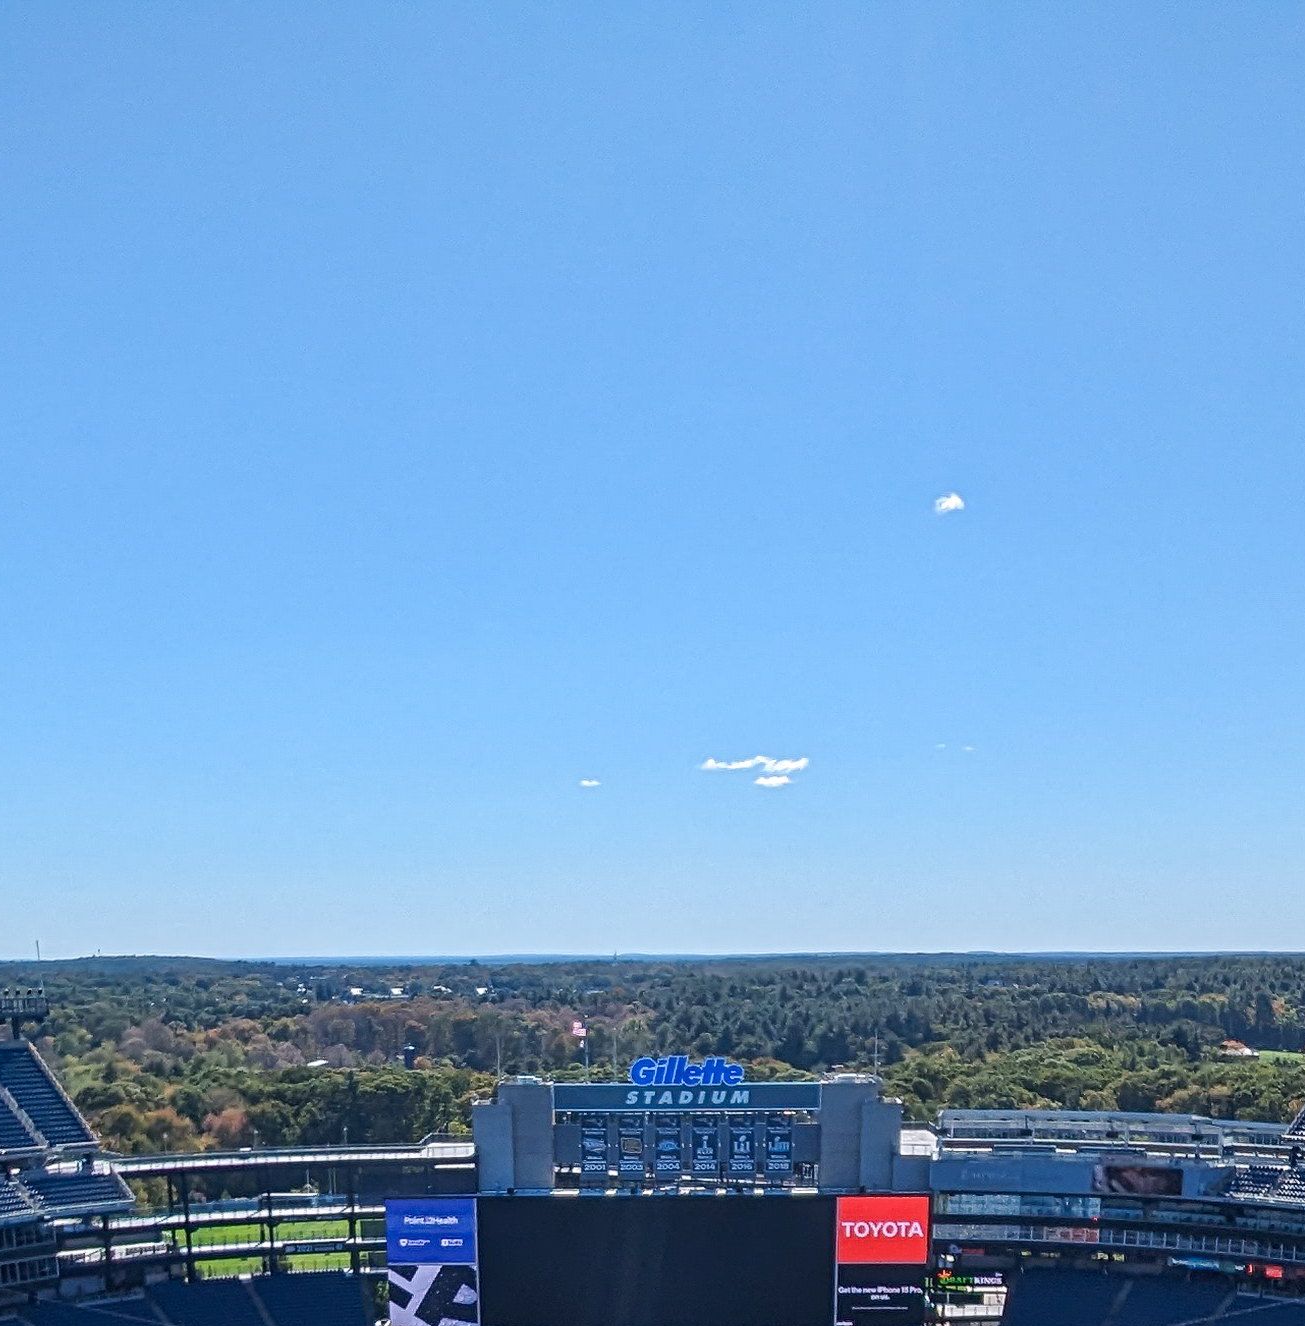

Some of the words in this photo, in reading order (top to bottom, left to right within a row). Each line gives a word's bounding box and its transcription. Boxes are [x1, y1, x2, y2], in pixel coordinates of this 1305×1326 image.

[630, 1055, 745, 1086] Gillette
[625, 1091, 750, 1105] STADIUM
[584, 1163, 606, 1171] 2001
[657, 1163, 681, 1171] 2004
[694, 1163, 715, 1171] 2014
[732, 1163, 753, 1171] 2016
[841, 1222, 924, 1238] TOYOTA
[838, 1286, 851, 1294] Get
[851, 1286, 862, 1294] the
[877, 1286, 900, 1294] iPhone
